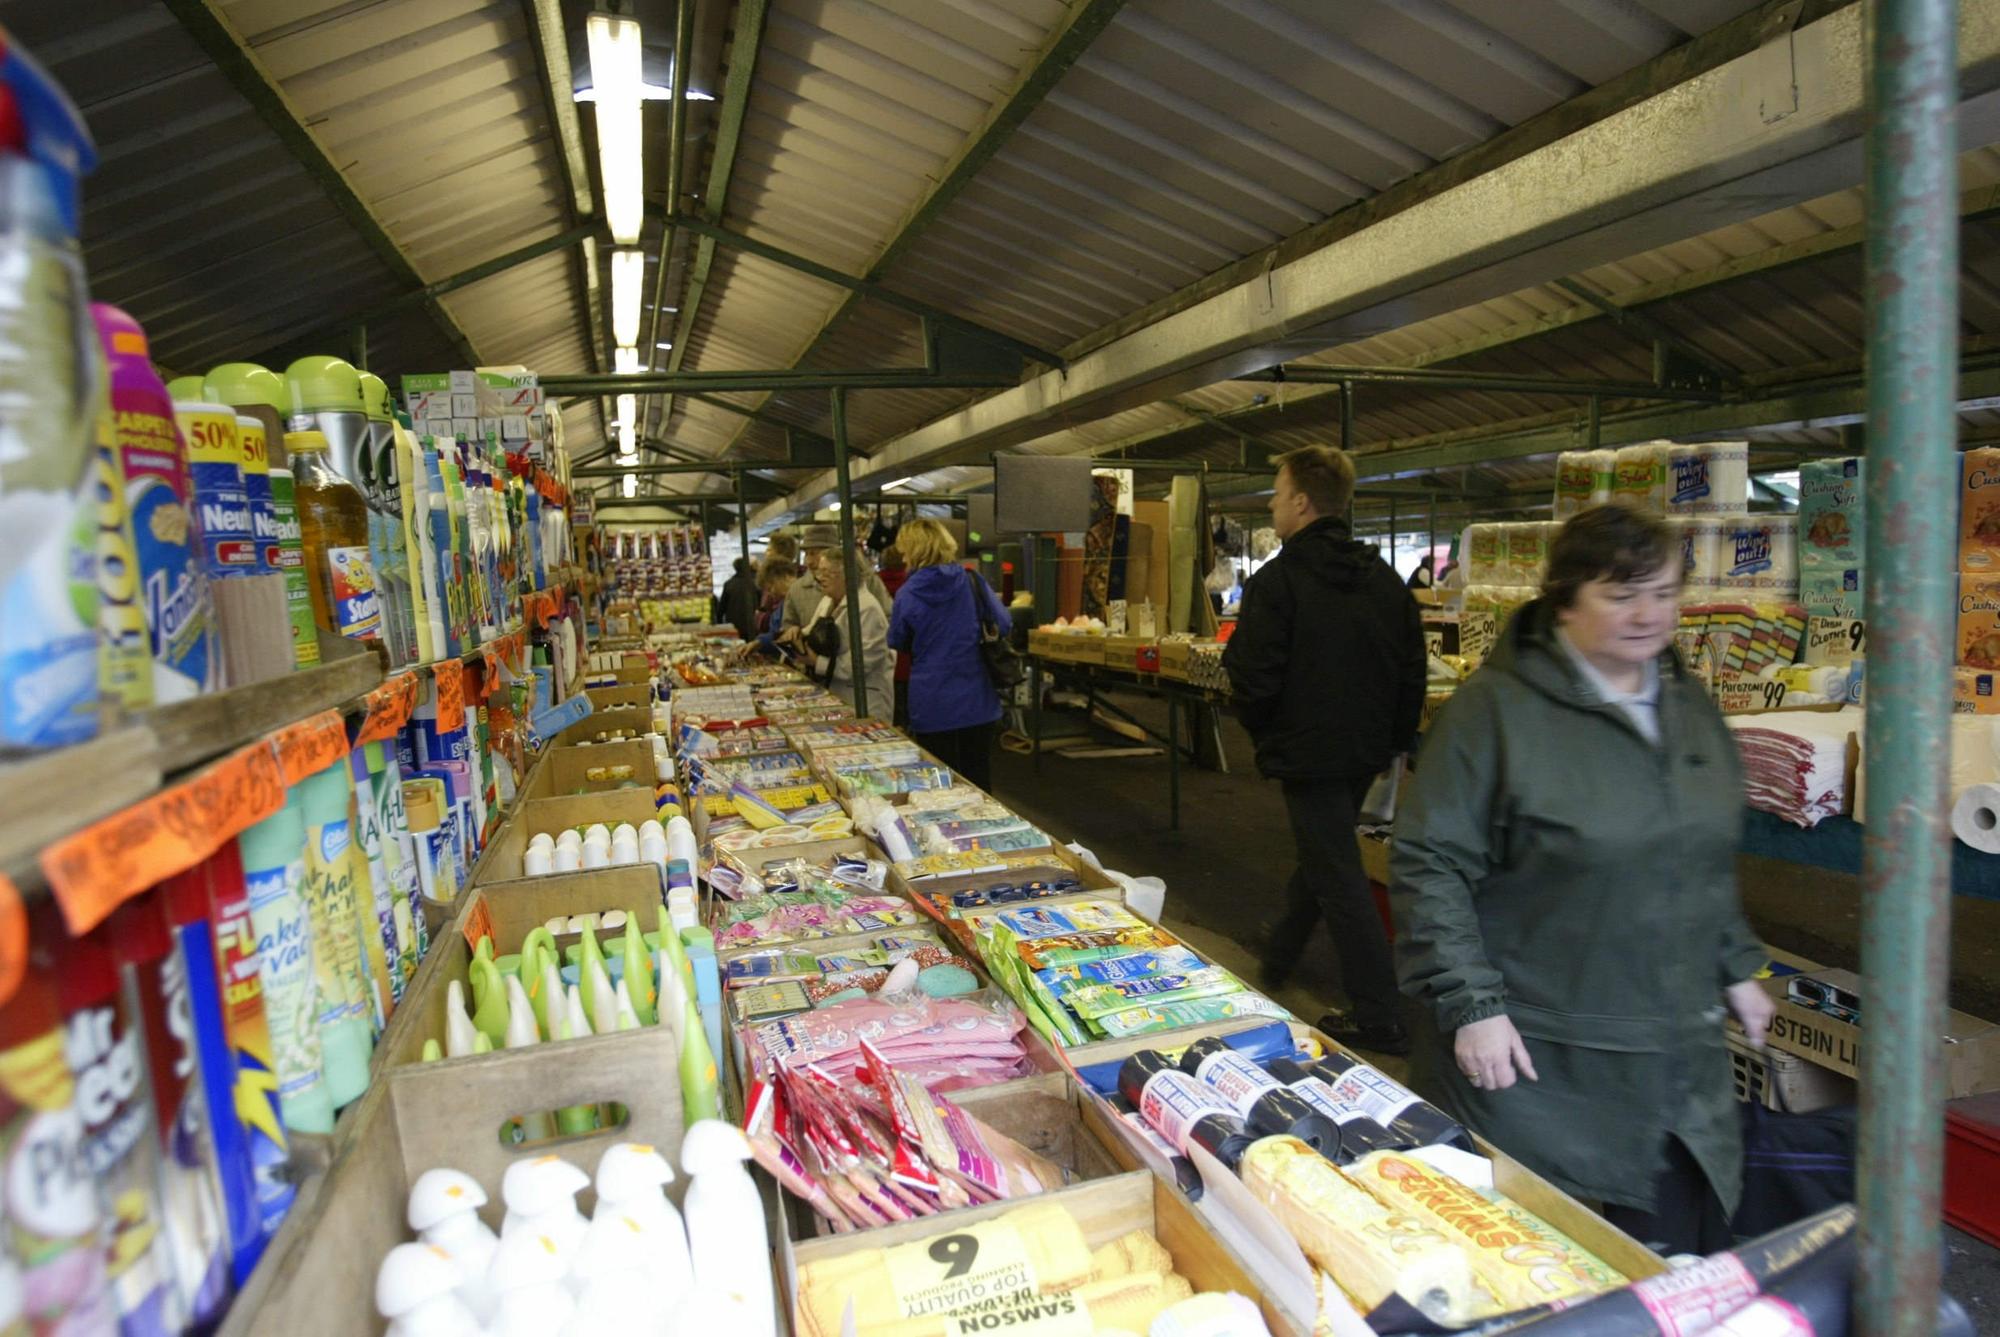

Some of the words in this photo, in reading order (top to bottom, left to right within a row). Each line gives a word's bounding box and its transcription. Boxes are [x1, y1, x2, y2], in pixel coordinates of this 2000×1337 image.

[243, 436, 265, 462] 50
[1801, 481, 1844, 498] Cushion
[1849, 621, 1866, 653] 9
[1763, 681, 1786, 709] 99
[1839, 1038, 1859, 1067] LI
[1399, 1172, 1519, 1250] SWING
[927, 1233, 980, 1282] 6
[902, 1279, 965, 1304] PRODUCTS
[992, 1270, 1030, 1293] TOP
[907, 1286, 987, 1319] QUALITY
[958, 1299, 1076, 1335] SAMSON
